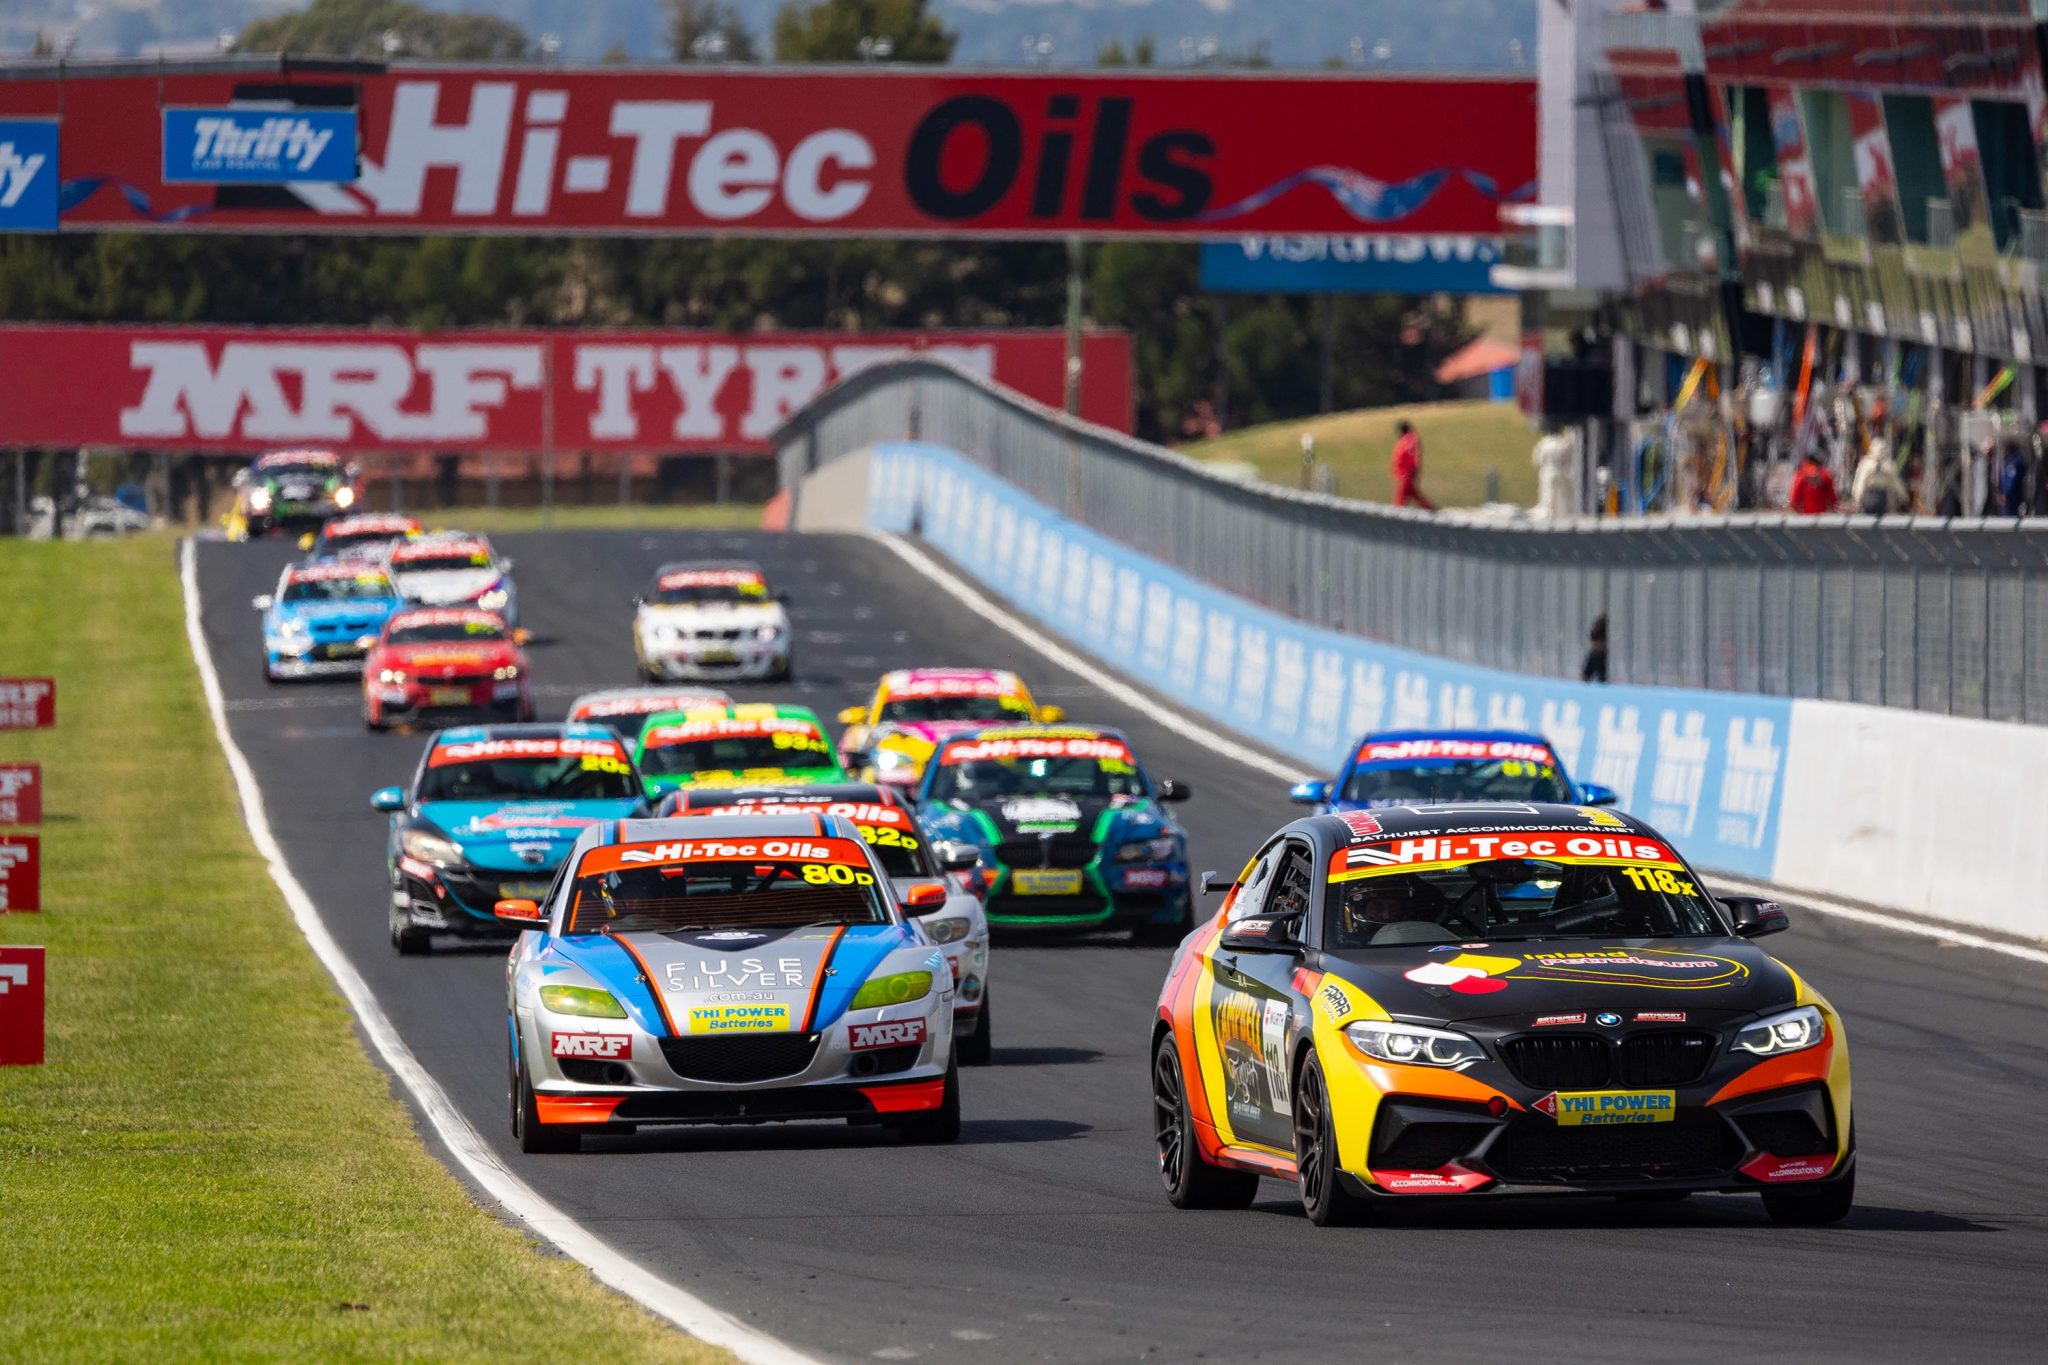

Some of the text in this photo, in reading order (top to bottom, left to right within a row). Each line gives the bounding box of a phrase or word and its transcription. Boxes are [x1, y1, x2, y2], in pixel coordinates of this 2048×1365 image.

[192, 117, 334, 172] Thrifty
[375, 80, 1218, 222] Hi-Tec Oils
[120, 340, 544, 441] MRF
[827, 803, 900, 823] Oils
[1350, 825, 1636, 844] BATHURST ACCOMMODATION.NET
[653, 841, 829, 862] Hi-Tec Oils
[1399, 837, 1661, 863] Hi-Tec Oils
[801, 864, 874, 886] 80D
[665, 958, 802, 979] FUSE
[668, 973, 805, 992] SILVER
[693, 1008, 785, 1019] YHI POWER
[709, 1018, 773, 1029] Batteries
[853, 1020, 925, 1048] MRF
[554, 1035, 629, 1057] MRF
[1561, 1095, 1672, 1113] YHI POWER
[1580, 1111, 1656, 1125] Batteries
